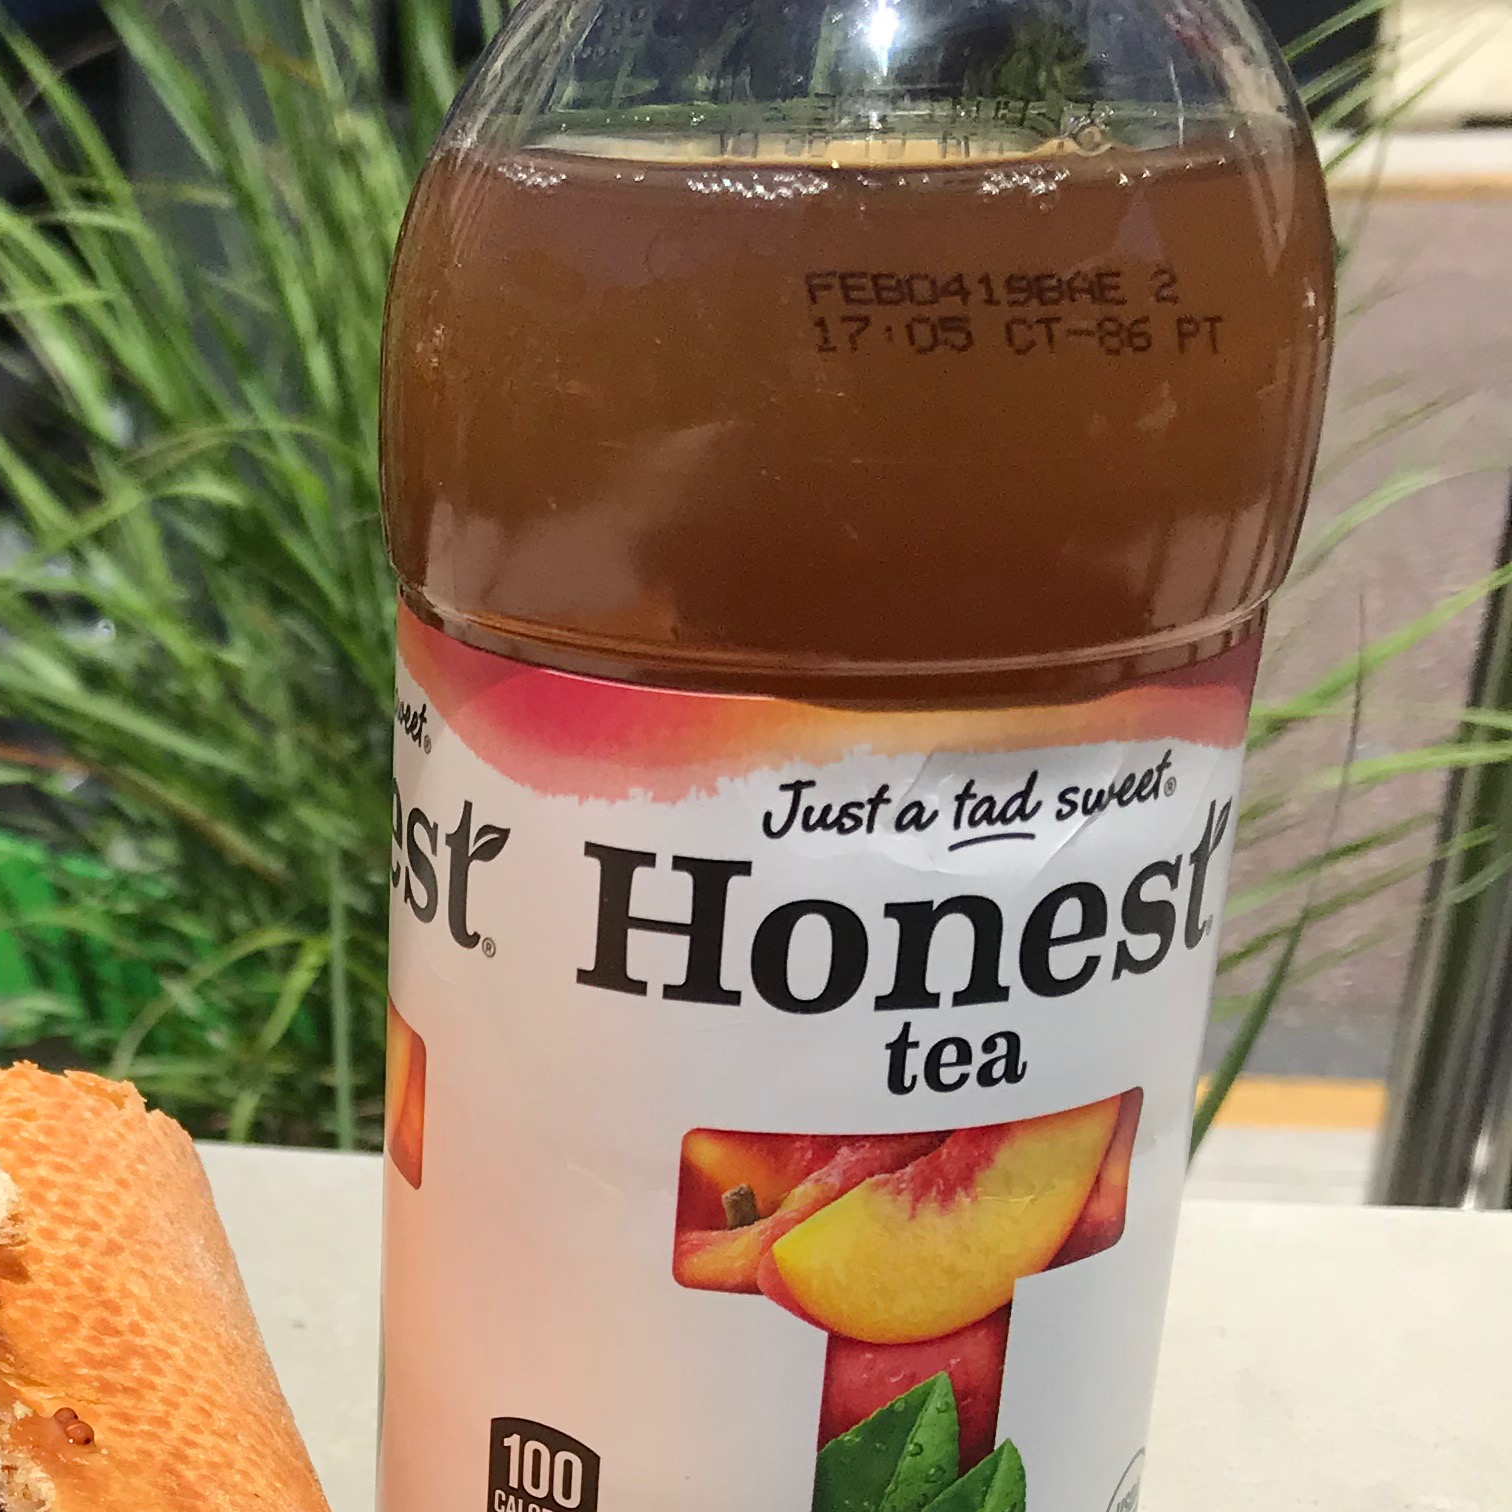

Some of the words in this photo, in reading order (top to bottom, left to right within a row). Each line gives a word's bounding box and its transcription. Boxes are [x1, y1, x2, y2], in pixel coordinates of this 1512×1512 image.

[1152, 268, 1179, 305] 2
[813, 314, 975, 355] 17:05
[1176, 315, 1224, 355] PT
[763, 780, 891, 839] Just
[895, 799, 939, 833] a
[952, 770, 1044, 831] tad
[1055, 749, 1173, 821] sweet
[575, 797, 1233, 1015] Honest
[886, 1022, 1028, 1096] tea
[503, 1433, 583, 1509] 100
